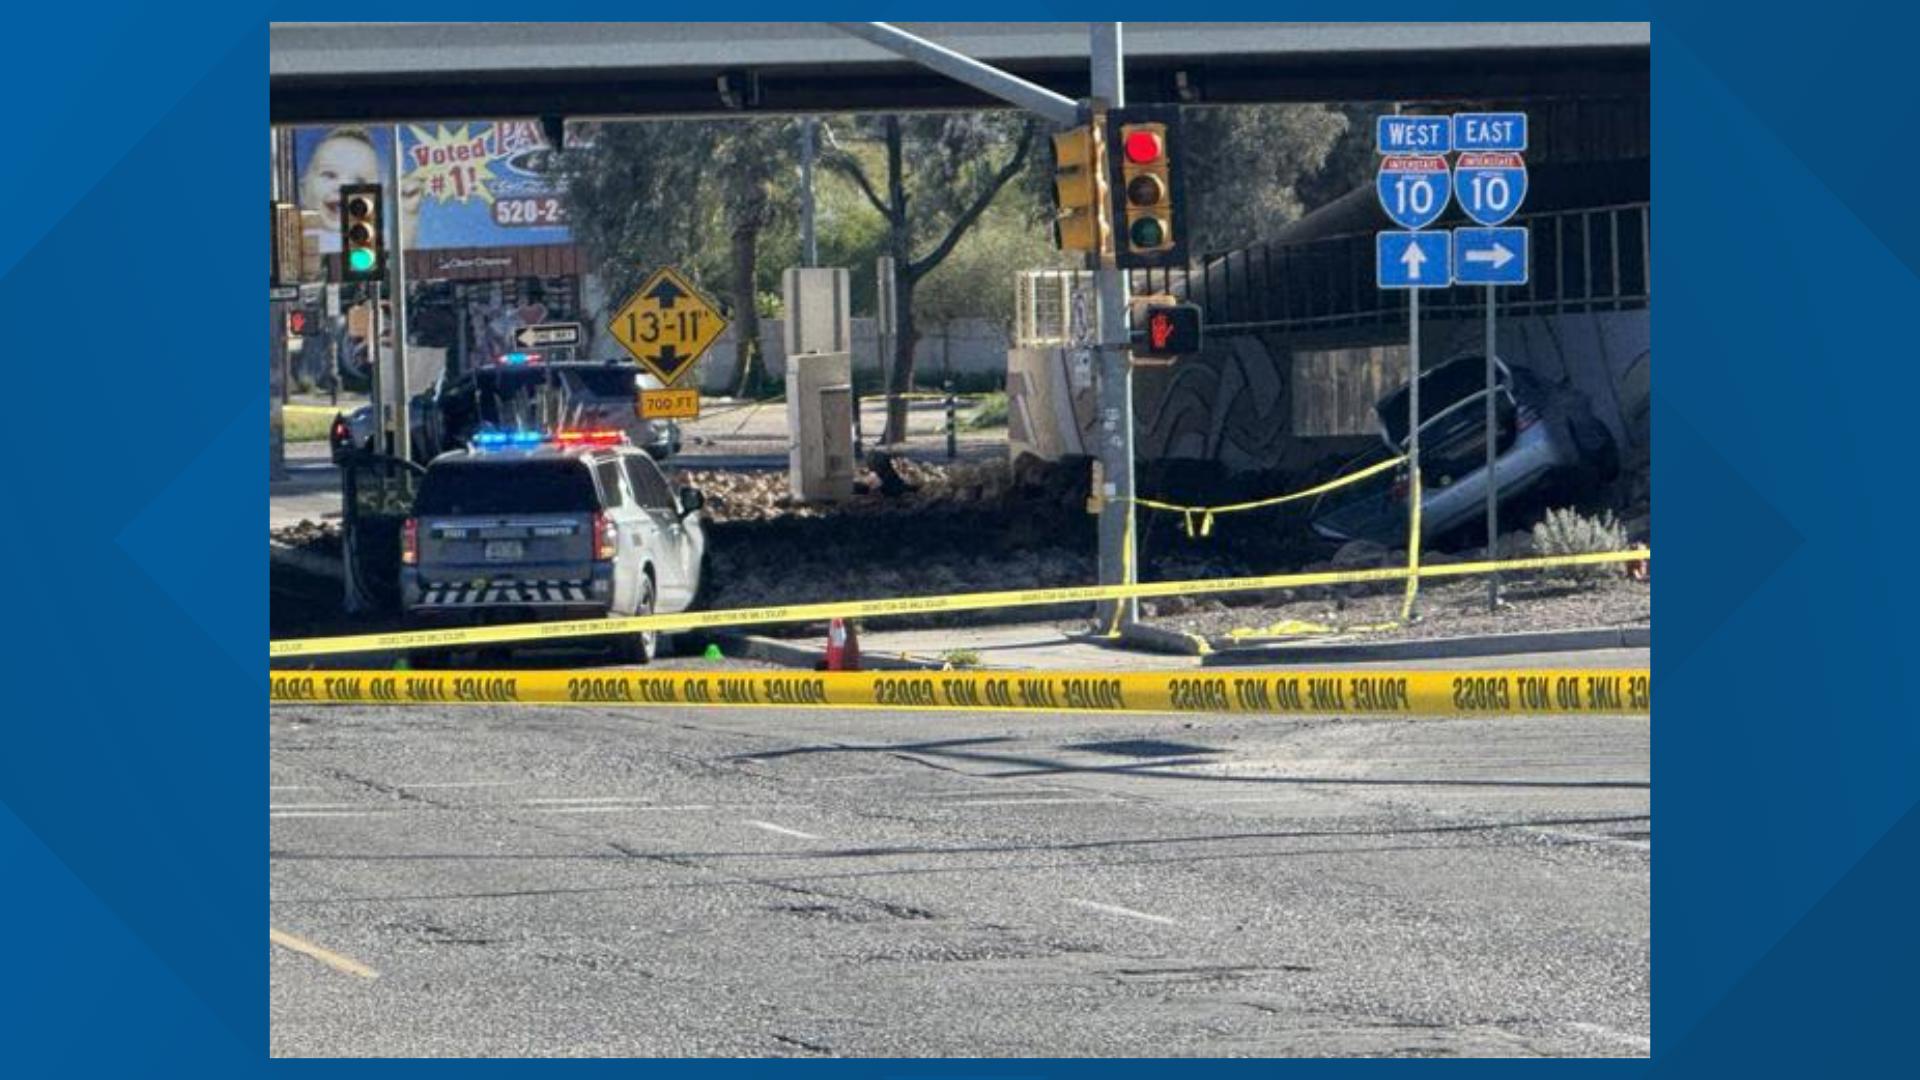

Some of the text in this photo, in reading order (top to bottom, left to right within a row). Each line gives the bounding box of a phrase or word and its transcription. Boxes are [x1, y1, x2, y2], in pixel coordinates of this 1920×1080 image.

[1388, 123, 1440, 146] WEST
[1466, 120, 1514, 143] EAST
[413, 137, 487, 167] Voted
[1388, 160, 1438, 169] INTERSTATE
[1463, 156, 1515, 167] INTERSTATE
[430, 165, 477, 197] #1!
[1472, 177, 1510, 211] 10
[1395, 180, 1434, 214] 10
[626, 309, 709, 343] 13'-11"
[646, 397, 692, 411] 700 FT
